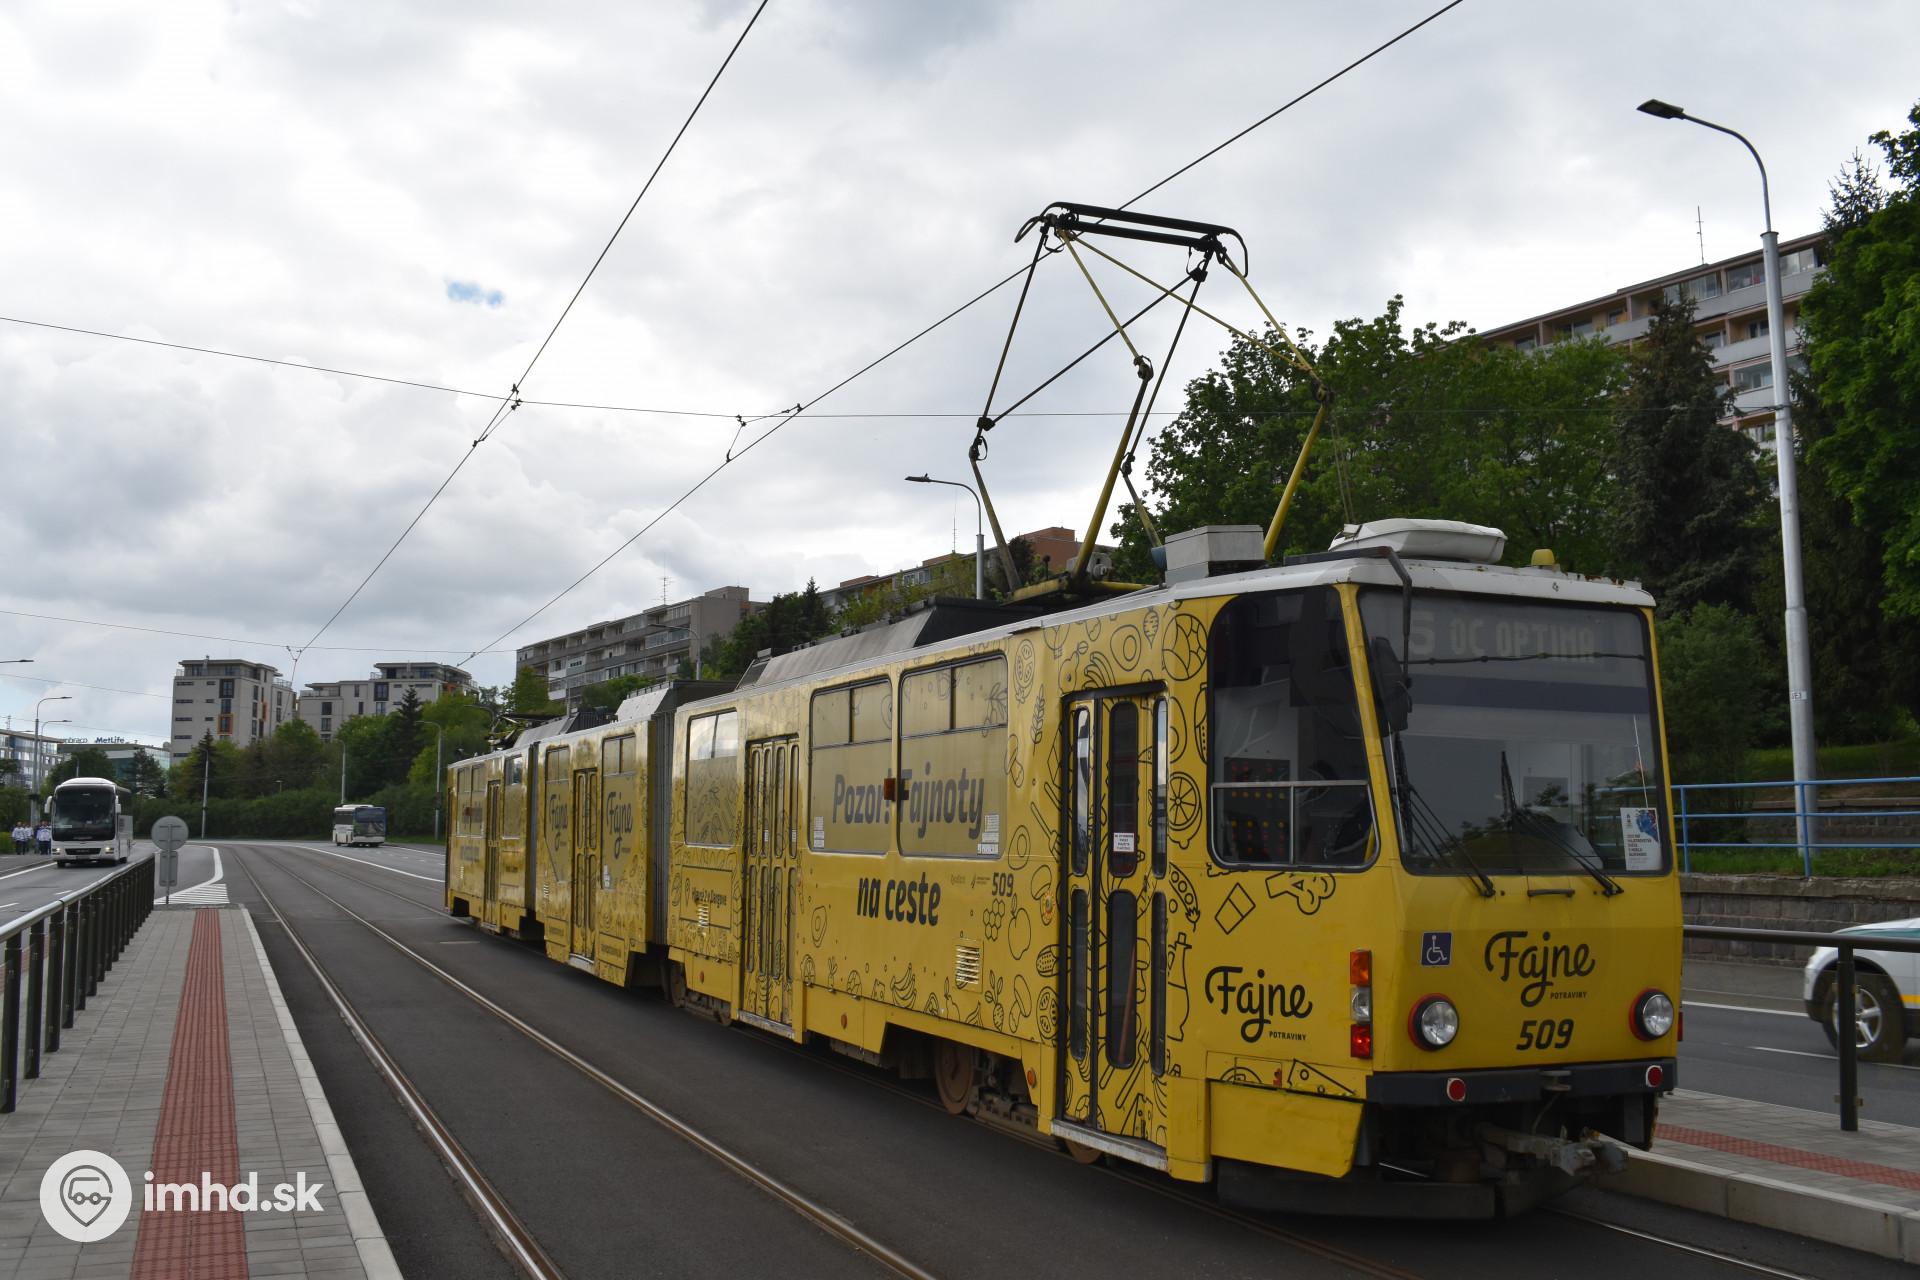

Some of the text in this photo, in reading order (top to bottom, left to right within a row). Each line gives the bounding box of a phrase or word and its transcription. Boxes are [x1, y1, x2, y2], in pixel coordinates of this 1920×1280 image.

[1449, 618, 1485, 657] OC
[1496, 620, 1598, 663] OPTIMA
[95, 735, 125, 744] MetLife
[606, 791, 634, 860] Fajne
[856, 872, 942, 927] na ceste
[991, 872, 1014, 897] 509
[1484, 930, 1596, 1008] Fajne
[1204, 965, 1314, 1044] Fajne
[1550, 991, 1588, 1000] POTRAVINY
[1268, 1030, 1307, 1041] POTRAVINY
[1515, 1018, 1575, 1051] 509
